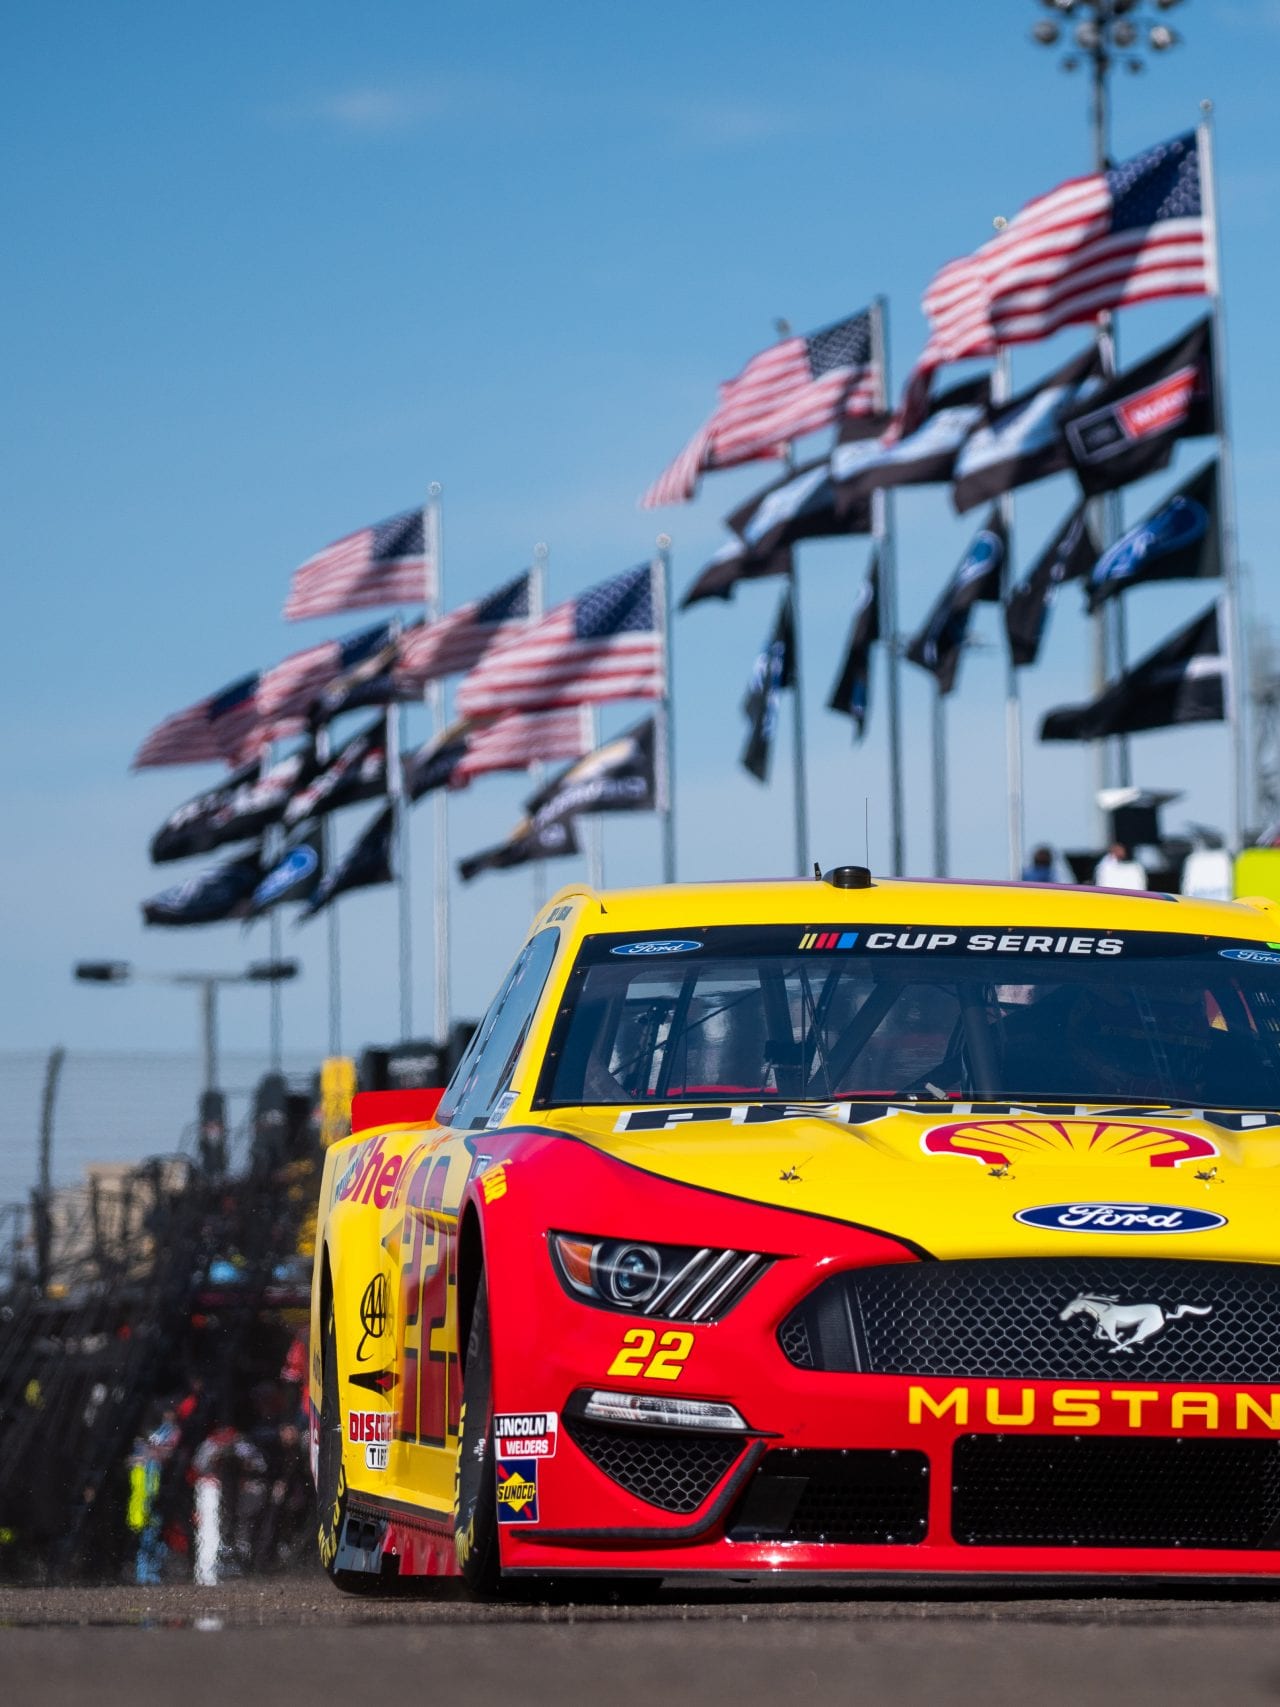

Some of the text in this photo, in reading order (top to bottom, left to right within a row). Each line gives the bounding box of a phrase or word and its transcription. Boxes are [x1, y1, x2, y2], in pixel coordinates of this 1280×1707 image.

[866, 932, 1124, 955] CUP SERIES
[1058, 1205, 1183, 1228] Ford
[607, 1328, 695, 1381] 22
[495, 1416, 545, 1437] LINCOLN
[506, 1439, 549, 1455] WELDERS
[498, 1485, 533, 1501] SUNOCO
